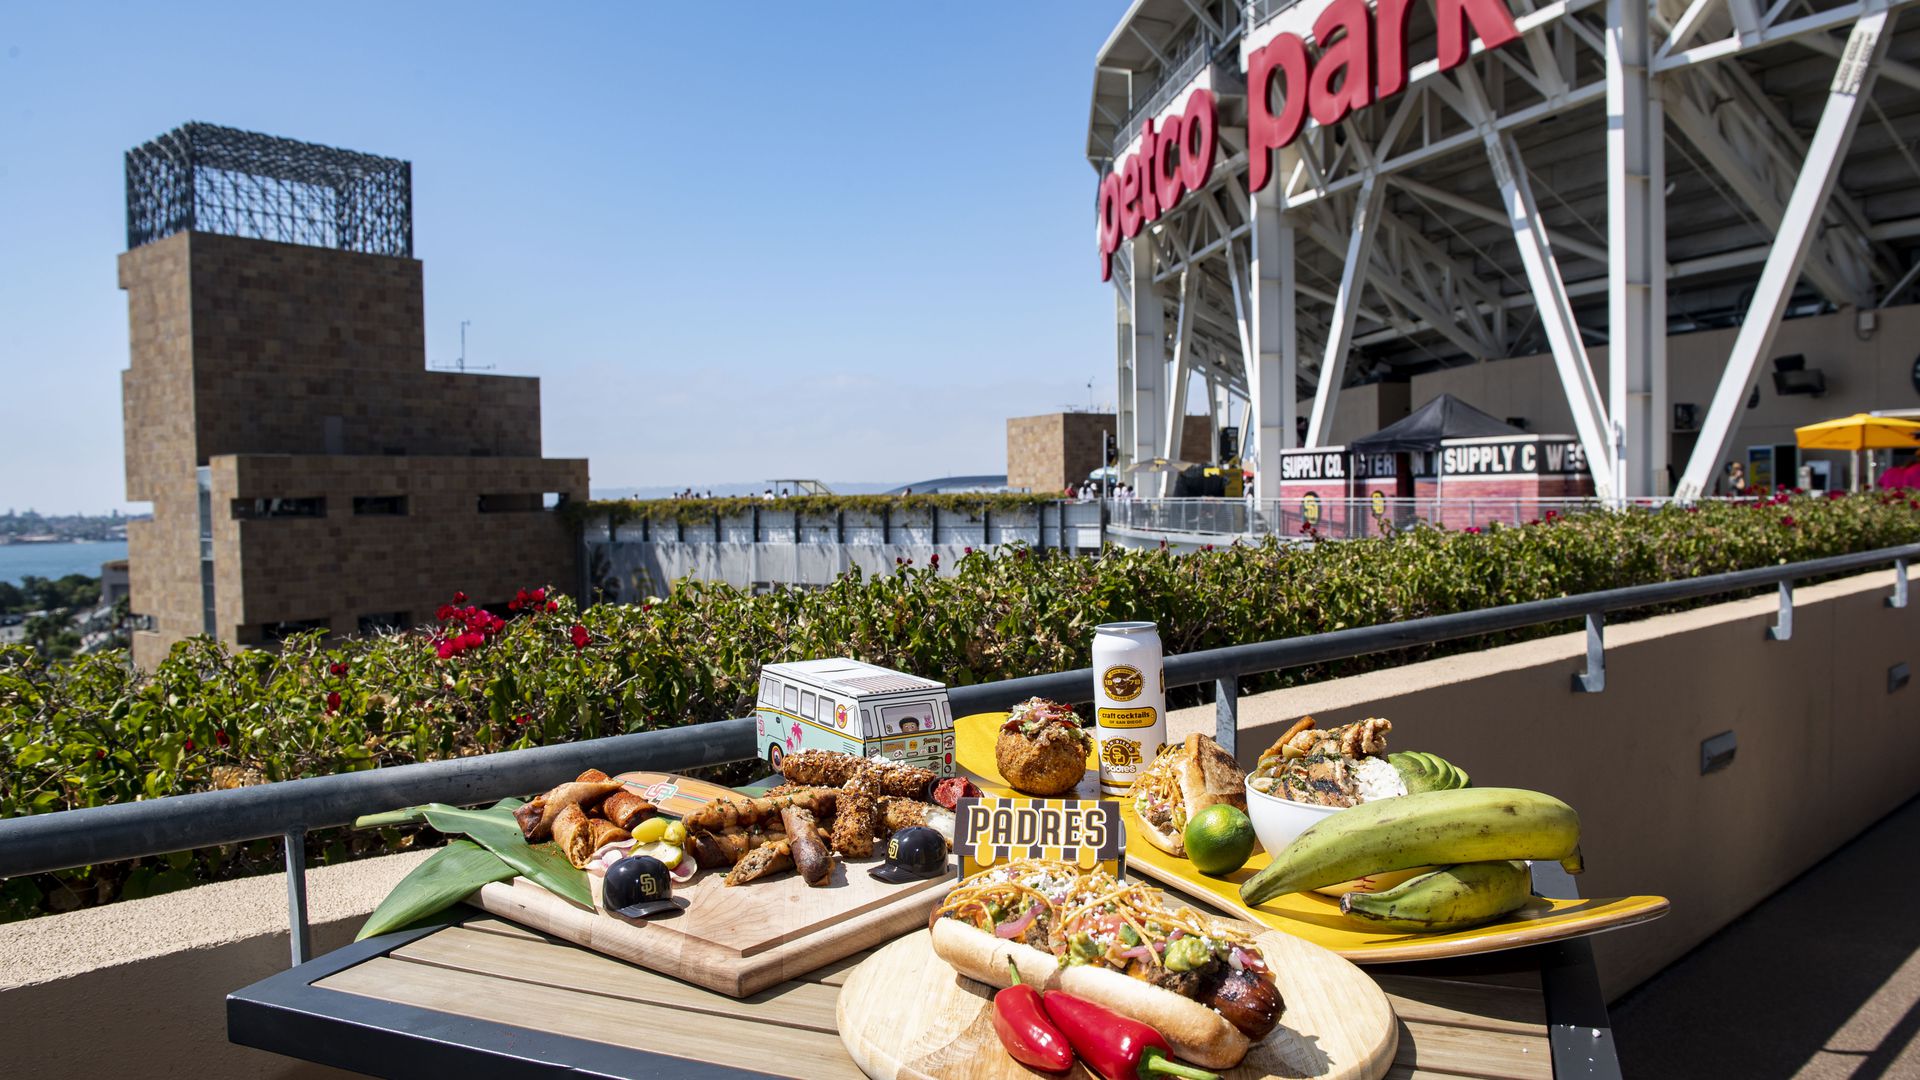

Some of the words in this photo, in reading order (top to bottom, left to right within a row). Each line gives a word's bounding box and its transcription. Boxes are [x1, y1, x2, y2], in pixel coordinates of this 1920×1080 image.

[1099, 89, 1217, 282] petco
[1282, 454, 1323, 478] SUPPLY
[1325, 453, 1345, 477] CO.
[1444, 444, 1516, 474] SUPPLY
[966, 805, 1107, 848] PADRES
[639, 873, 657, 896] SD
